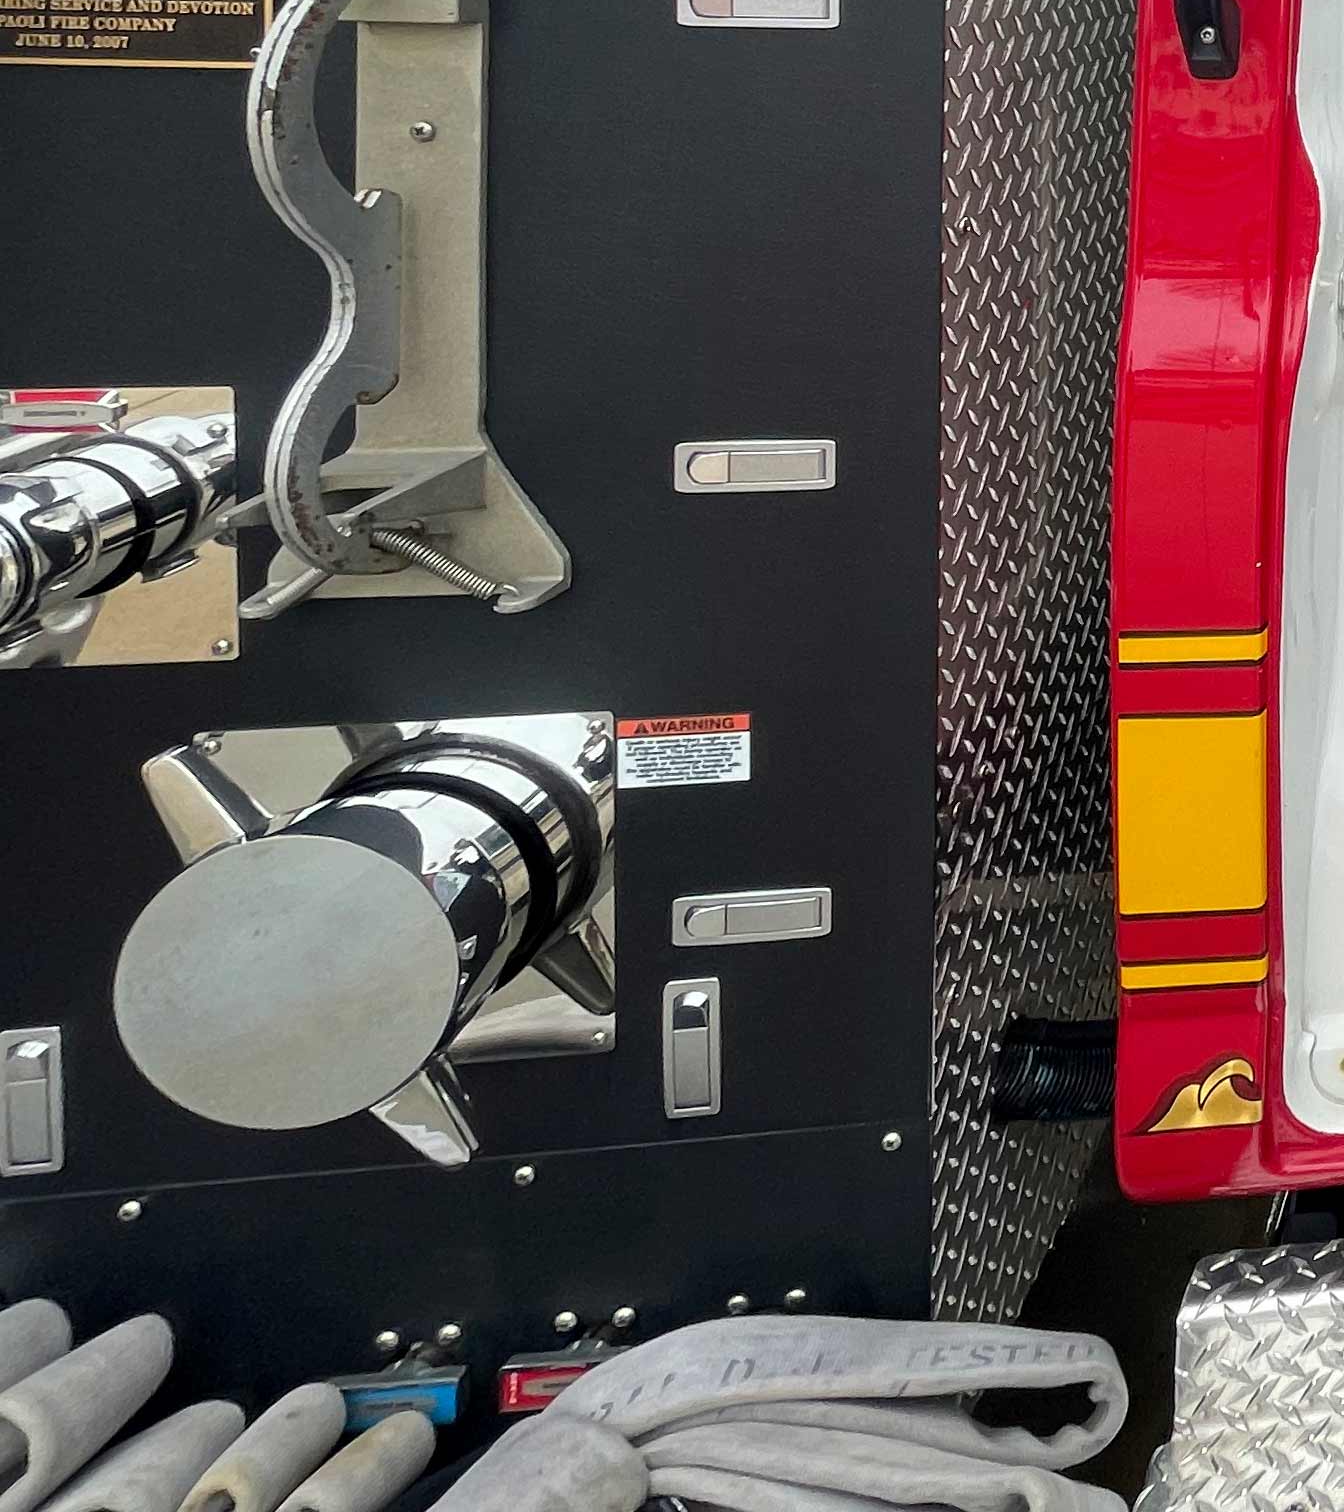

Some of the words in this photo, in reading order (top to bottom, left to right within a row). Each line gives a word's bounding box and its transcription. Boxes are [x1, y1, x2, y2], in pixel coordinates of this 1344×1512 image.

[126, 0, 162, 13] AND
[167, 0, 255, 15] DEVOTION
[0, 14, 46, 29] PAOLI
[50, 16, 90, 30] FIRE
[93, 17, 177, 32] COMPANY
[15, 34, 62, 47] JUNE
[650, 717, 735, 733] WARNING
